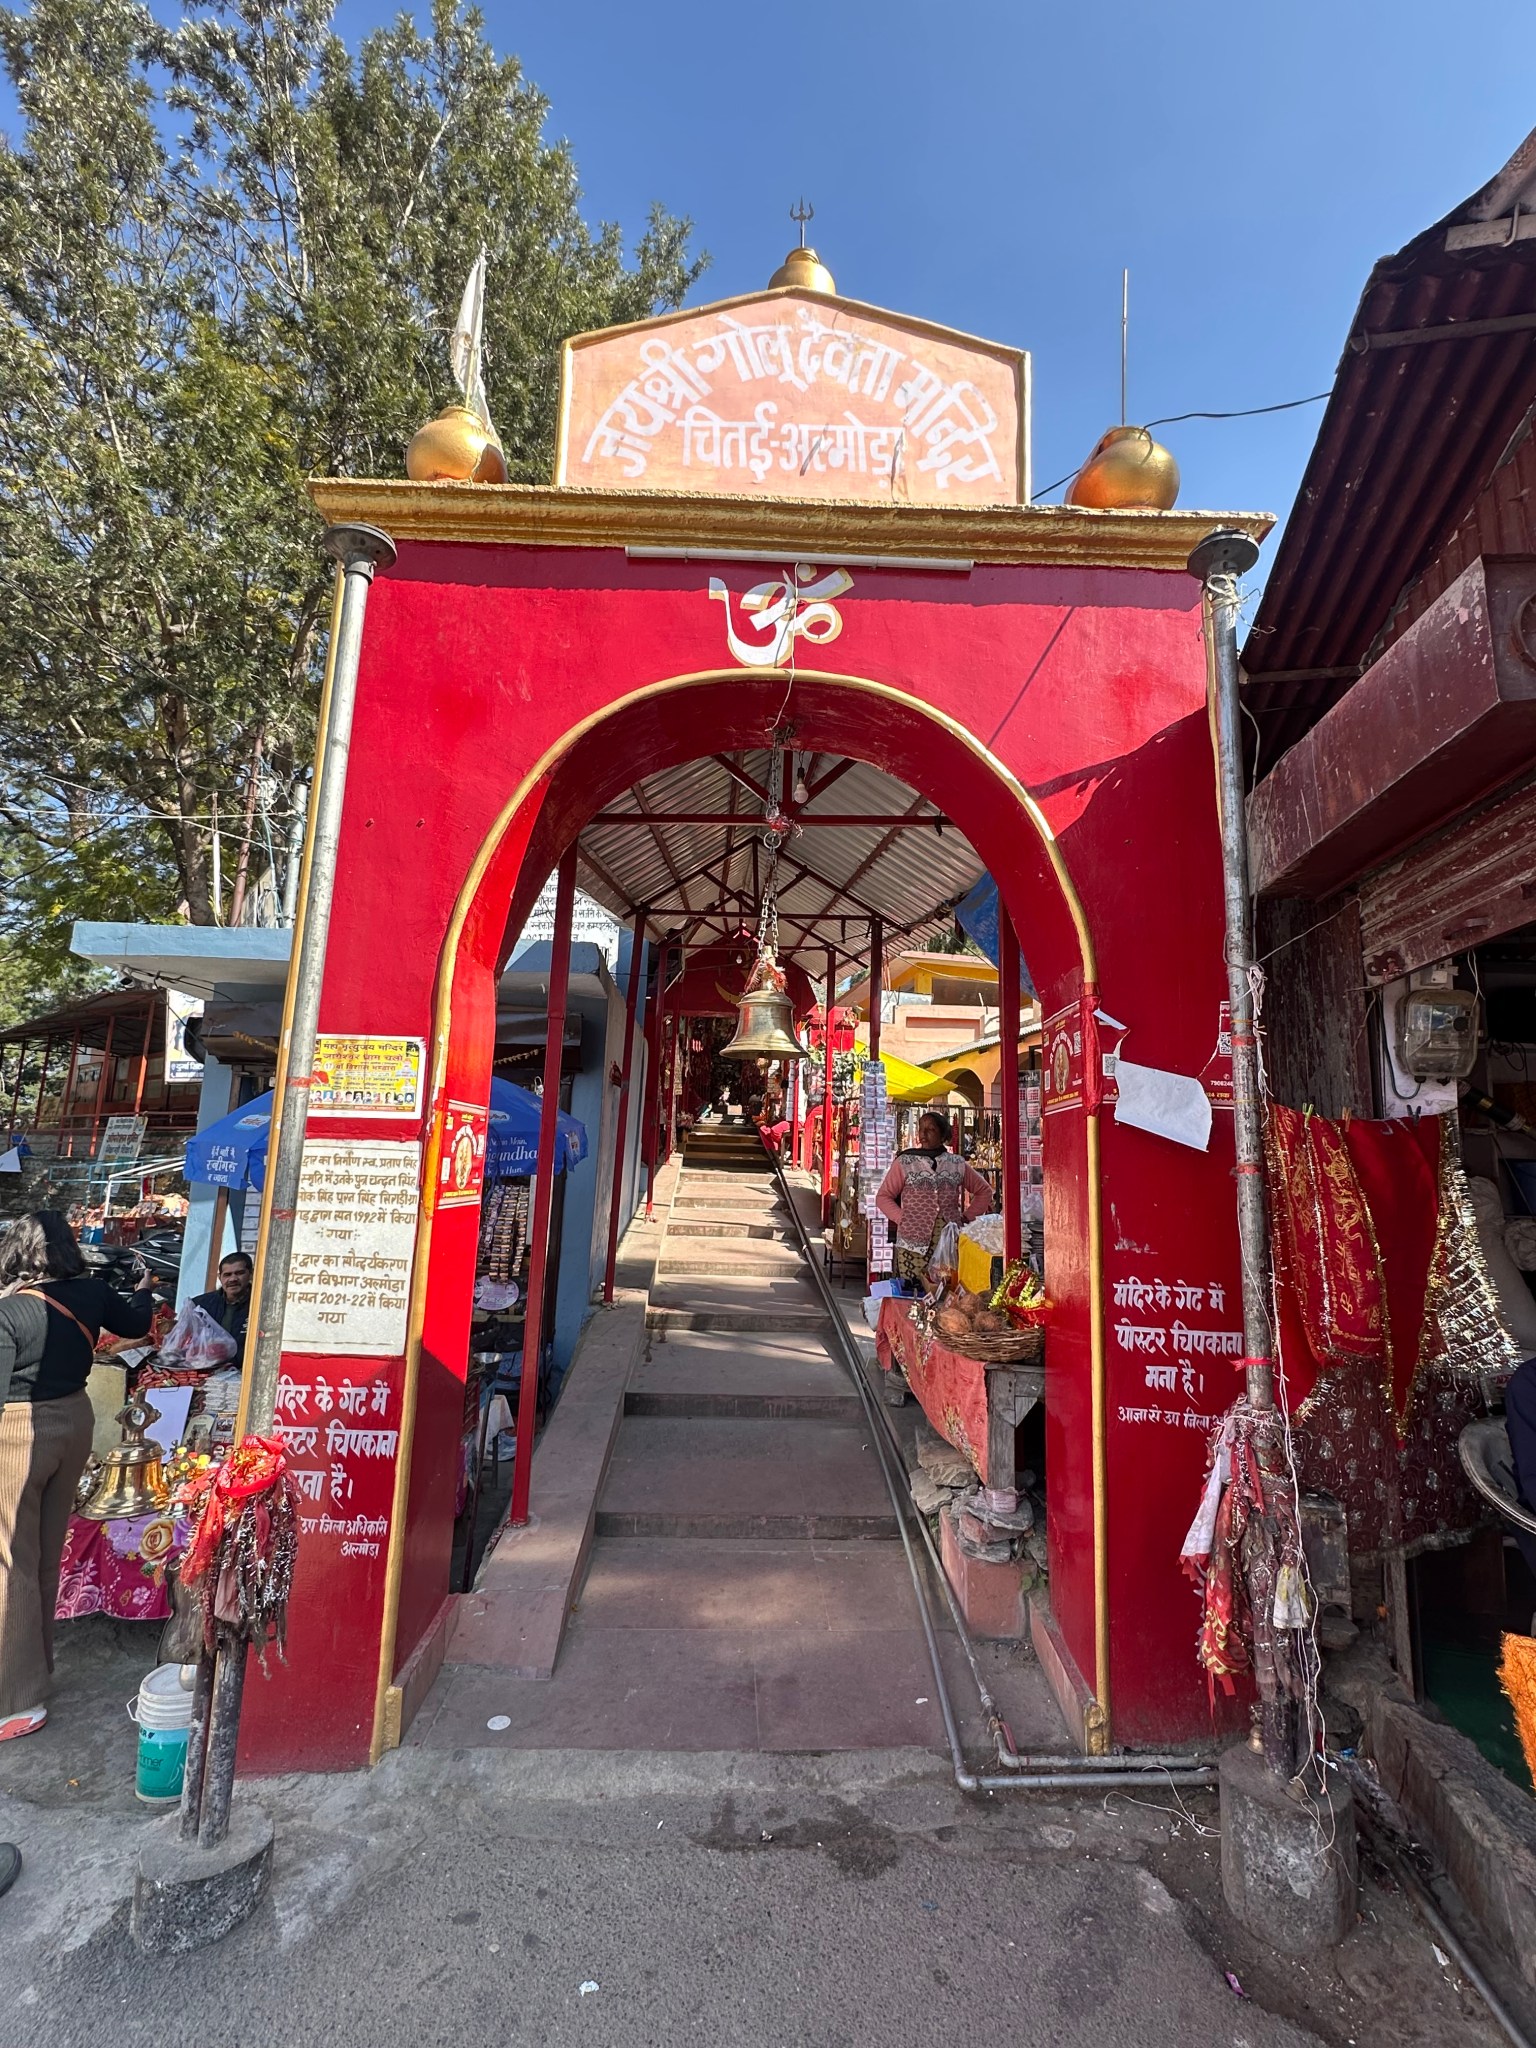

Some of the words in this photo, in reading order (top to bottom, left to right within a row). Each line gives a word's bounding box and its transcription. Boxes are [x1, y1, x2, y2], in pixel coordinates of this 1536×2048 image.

[692, 313, 809, 393] गोलू
[797, 306, 908, 403] देवता
[892, 359, 1003, 490] मन्दिर
[319, 1155, 332, 1165] का
[333, 1150, 361, 1167] निर्माण
[379, 1158, 402, 1169] प्रताप
[403, 1156, 418, 1170] सिंह
[301, 1171, 323, 1187] स्मृति
[325, 1169, 334, 1183] में
[333, 1170, 354, 1185] उनके
[355, 1174, 368, 1189] पुत्र
[369, 1175, 397, 1188] चन्दन
[398, 1172, 416, 1187] सिंह
[317, 1189, 334, 1204] सिंह
[358, 1189, 376, 1206] सिंह
[334, 1210, 352, 1223] सन
[354, 1211, 377, 1223] 1992
[377, 1208, 388, 1223] में
[390, 1209, 416, 1224] किया
[299, 1253, 321, 1268] द्वार
[322, 1254, 340, 1267] का
[318, 1270, 359, 1287] विभाग
[298, 1292, 318, 1304] सन
[320, 1292, 367, 1307] 2021-22
[368, 1291, 378, 1307] में
[379, 1293, 407, 1310] किया
[1113, 1276, 1157, 1314] मंदिर
[1154, 1278, 1171, 1310] के
[1173, 1279, 1205, 1312] गेट
[1207, 1282, 1226, 1314] में
[317, 1312, 347, 1325] गया
[1114, 1318, 1169, 1356] पोस्टर
[1170, 1319, 1244, 1357] चिपकाना
[1145, 1365, 1179, 1393] मना
[314, 1375, 335, 1413] के
[337, 1378, 369, 1416] गेट
[372, 1380, 391, 1416] में
[1118, 1406, 1152, 1424] आज्ञा
[1164, 1410, 1180, 1427] उप
[1183, 1406, 1211, 1434] जिला
[325, 1418, 398, 1459] चिपकाना
[319, 1513, 345, 1535] जिला
